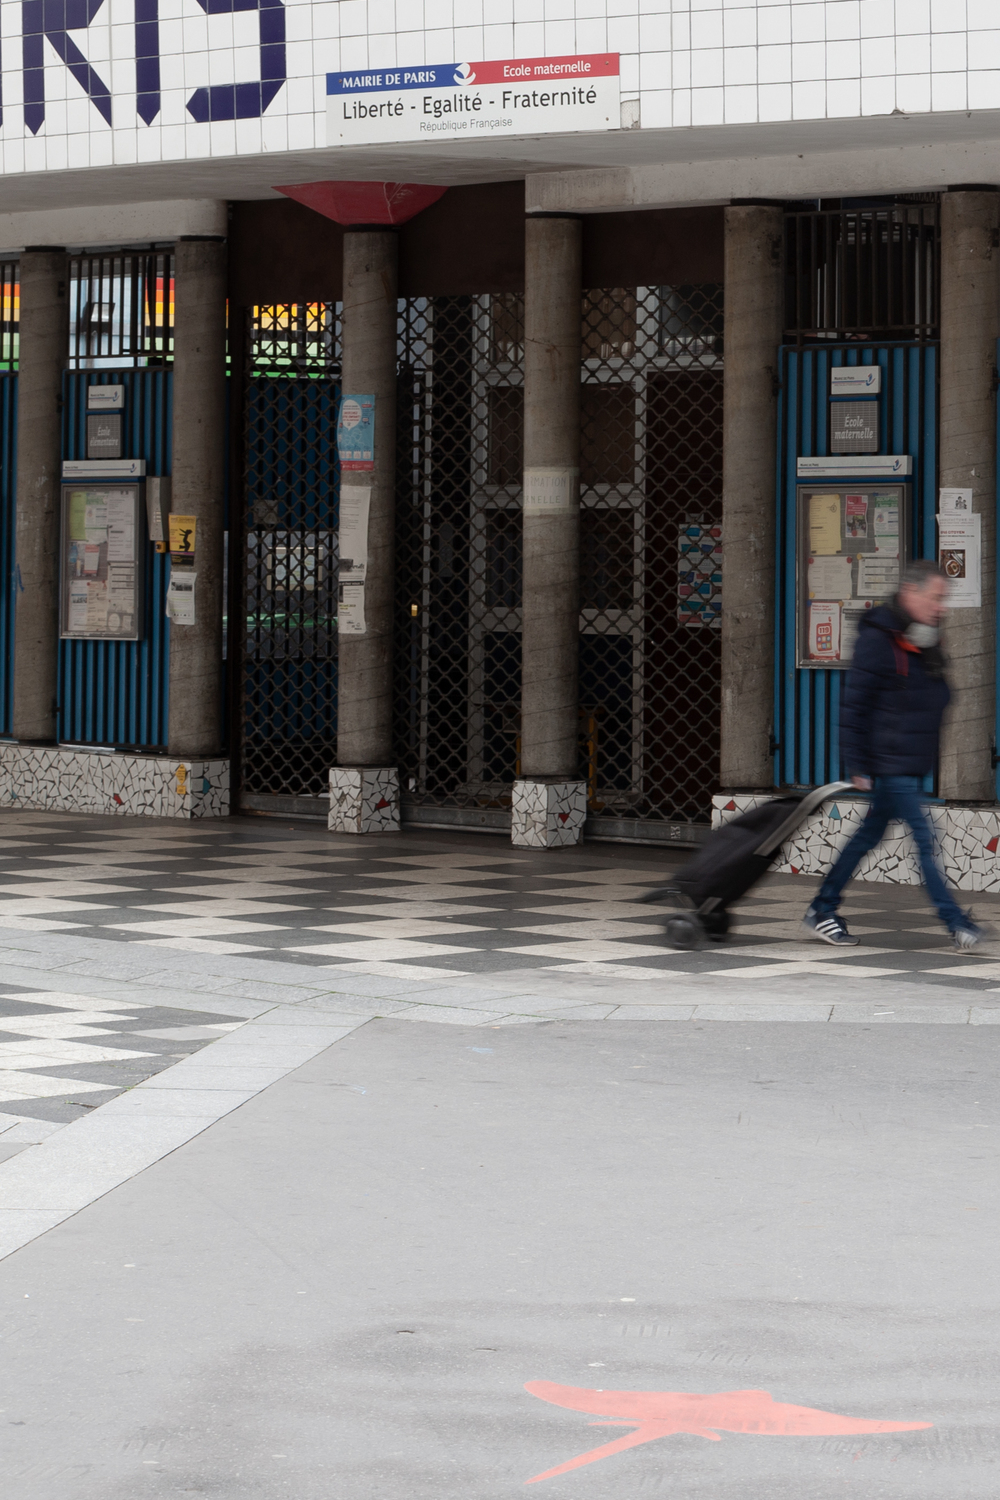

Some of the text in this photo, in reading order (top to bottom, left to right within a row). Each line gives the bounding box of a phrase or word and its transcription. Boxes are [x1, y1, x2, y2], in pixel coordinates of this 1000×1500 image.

[503, 61, 592, 78] Ecole maternelle
[342, 70, 436, 89] MAIRIE DE PARIS
[343, 98, 404, 120] Liberté
[423, 93, 482, 118] Egalité
[502, 85, 597, 109] Fraternité
[420, 117, 513, 133] République Française
[844, 414, 864, 427] École
[97, 425, 111, 436] École
[834, 427, 874, 439] maternelle
[90, 436, 118, 447] élémentaire
